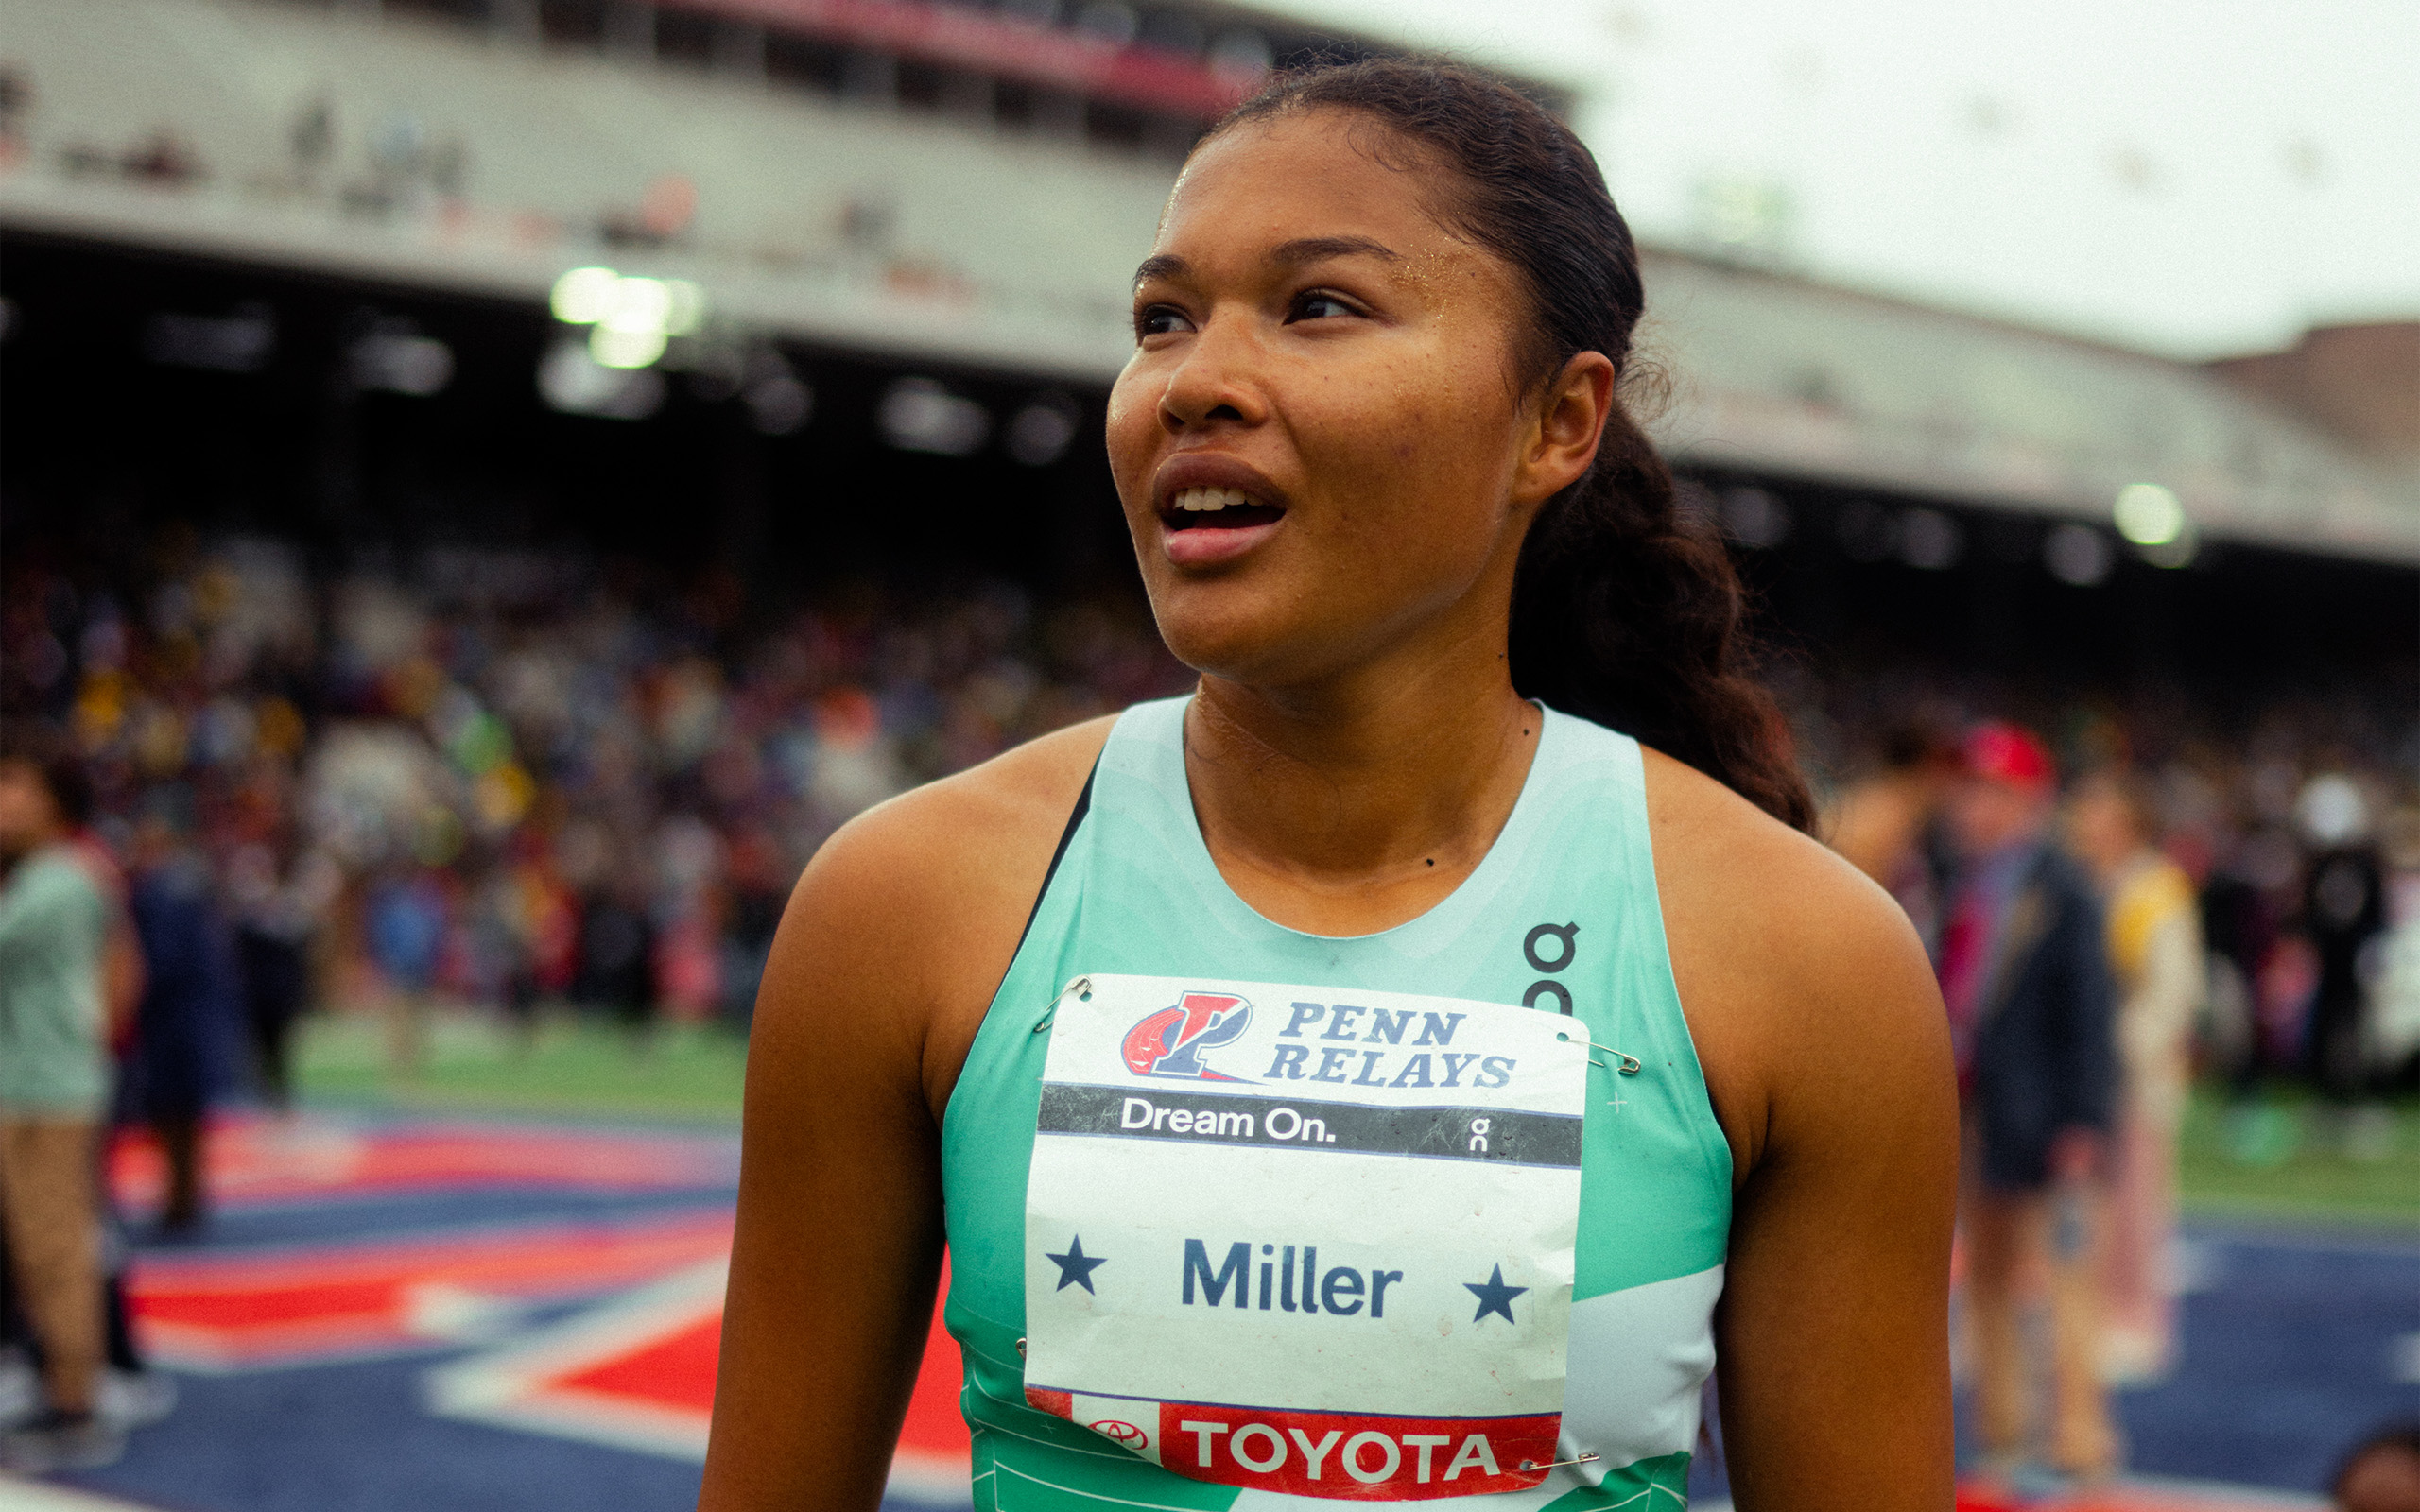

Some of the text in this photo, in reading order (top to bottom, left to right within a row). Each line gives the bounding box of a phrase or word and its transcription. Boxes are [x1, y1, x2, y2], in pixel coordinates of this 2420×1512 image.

[1278, 1002, 1466, 1045] PENN
[1263, 1045, 1517, 1088] RELAYS
[1121, 1098, 1336, 1143] Dream On.
[1182, 1238, 1404, 1318] Miller
[1180, 1420, 1501, 1484] TOYOTA
